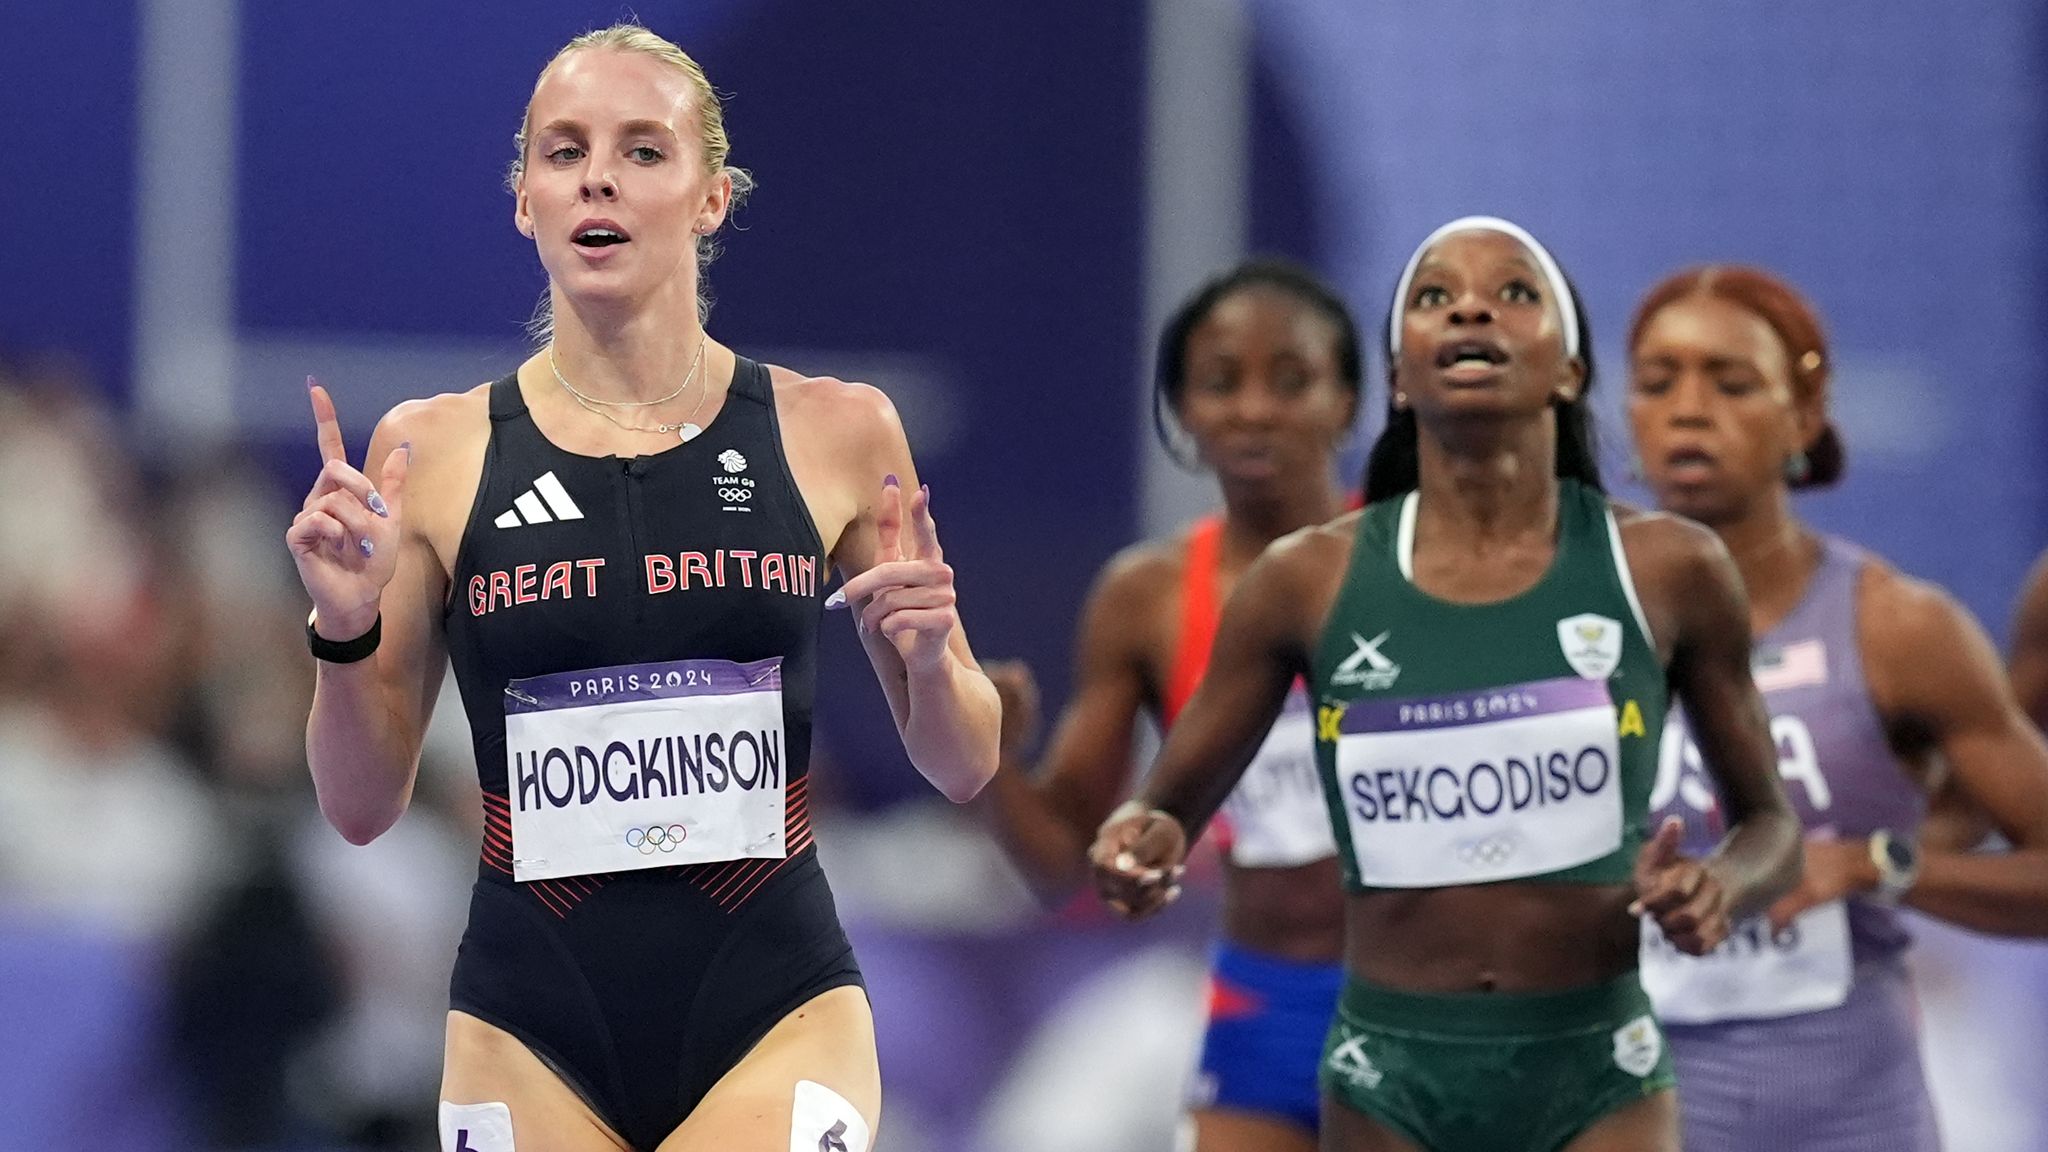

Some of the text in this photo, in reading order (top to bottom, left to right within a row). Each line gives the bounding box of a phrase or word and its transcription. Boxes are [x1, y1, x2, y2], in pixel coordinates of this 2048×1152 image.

[712, 476, 755, 488] TEAM GB
[468, 549, 816, 617] GREAT BRITAIN
[570, 670, 712, 697] PARIS 2024
[1399, 700, 1469, 725] PARIS
[515, 729, 780, 812] HODGKINSON
[1351, 746, 1609, 823] SEKGODISO
